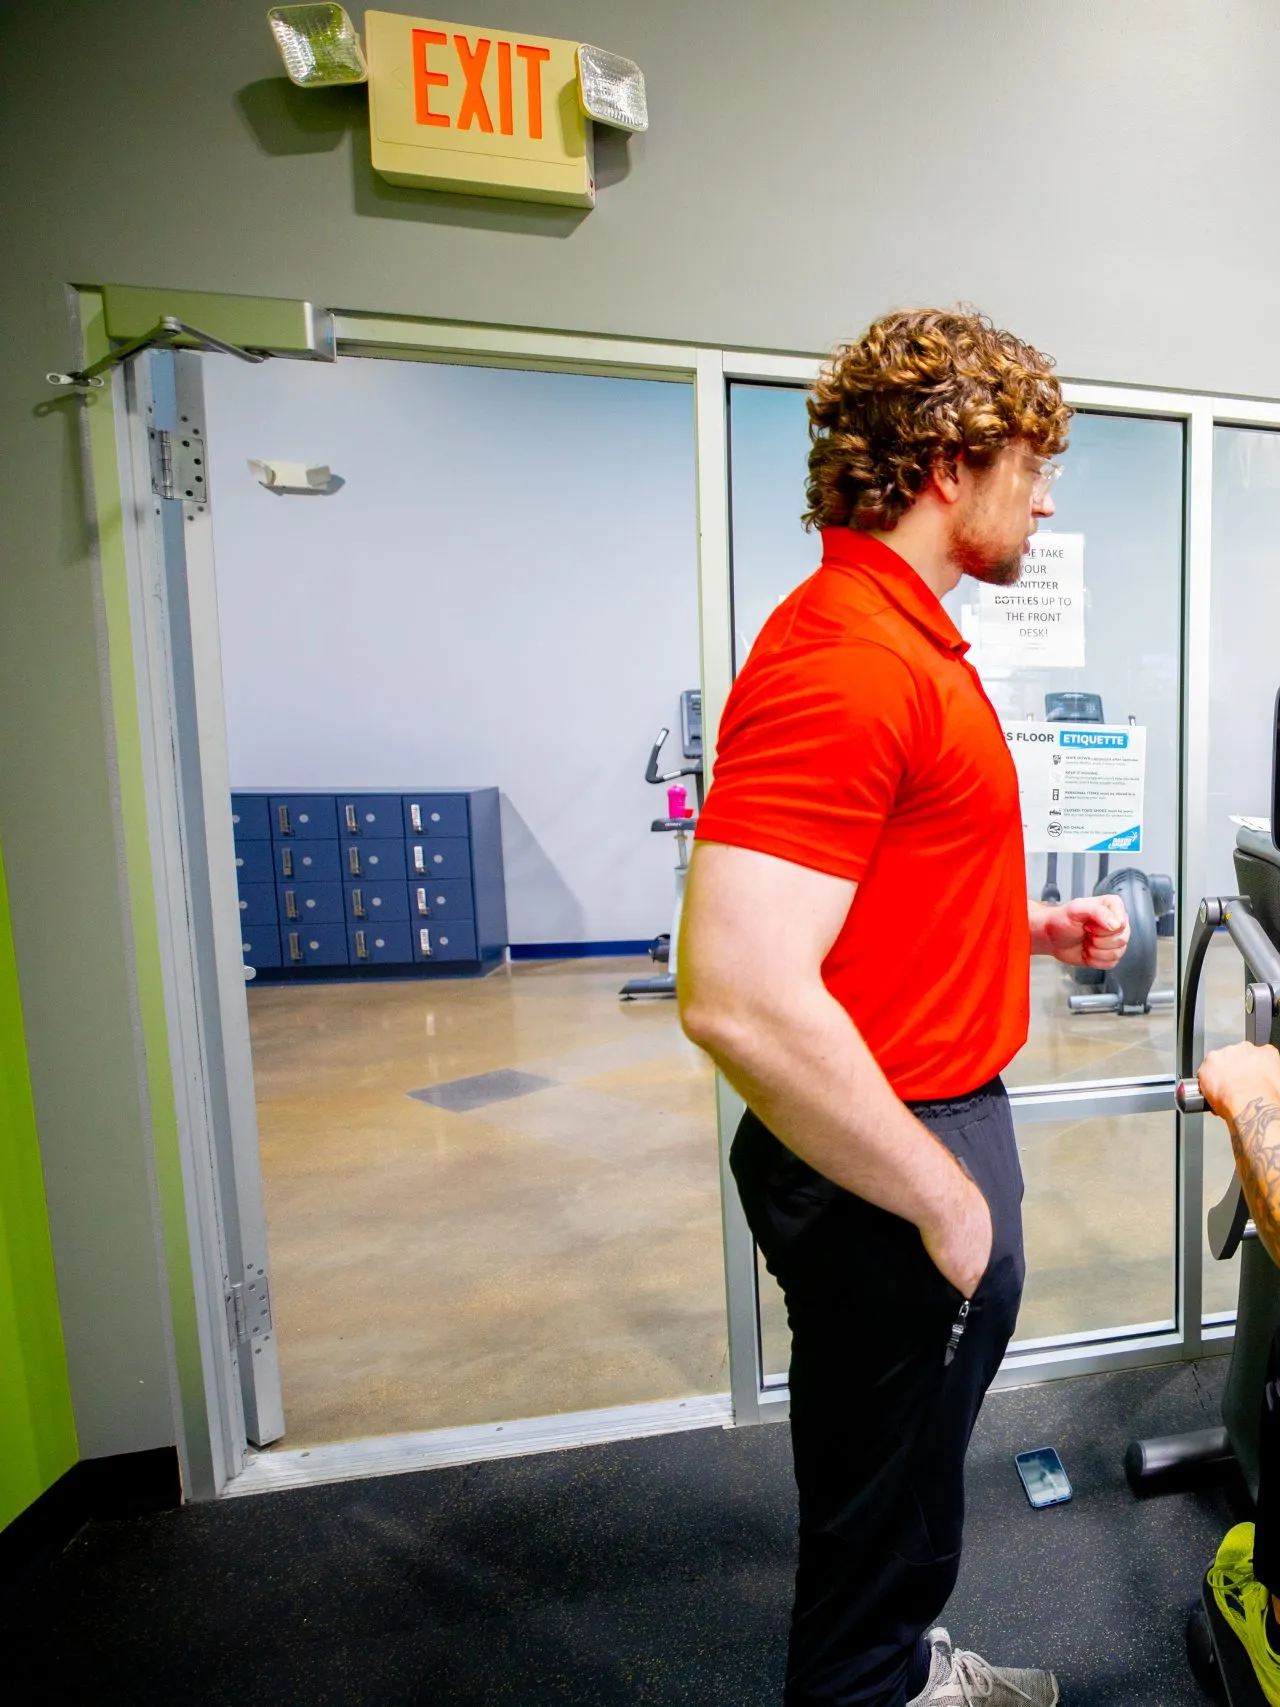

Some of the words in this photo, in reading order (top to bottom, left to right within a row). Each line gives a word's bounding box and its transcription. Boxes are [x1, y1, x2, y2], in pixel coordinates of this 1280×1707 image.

[412, 29, 550, 139] EXIT
[1040, 548, 1064, 558] TAKE
[1022, 564, 1047, 574] OUR
[994, 596, 1039, 605] BOTTLES
[1041, 596, 1055, 606] UP
[1058, 597, 1072, 606] TO
[1005, 612, 1025, 621] THE
[1028, 612, 1062, 622] FRONT
[1019, 628, 1048, 637] DESK!
[1016, 732, 1055, 743] FLOOR
[1063, 733, 1125, 745] ETIQUETTE
